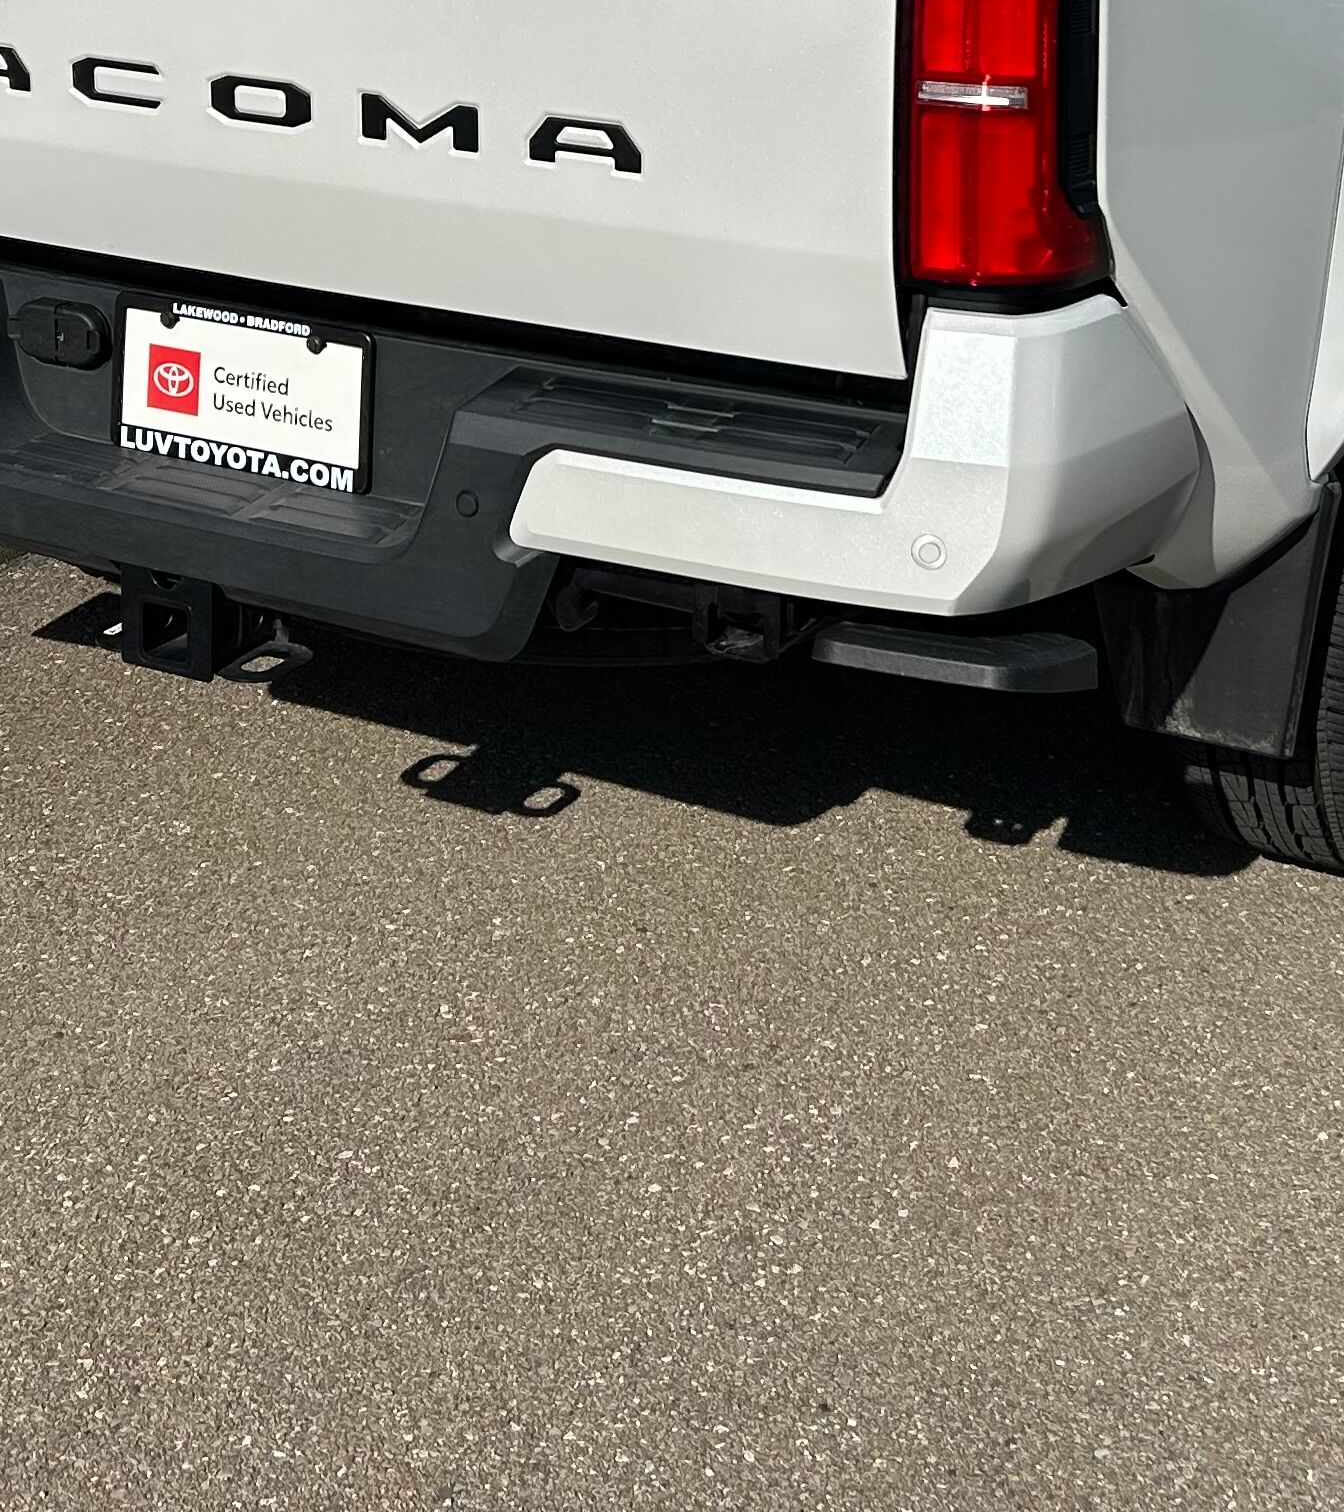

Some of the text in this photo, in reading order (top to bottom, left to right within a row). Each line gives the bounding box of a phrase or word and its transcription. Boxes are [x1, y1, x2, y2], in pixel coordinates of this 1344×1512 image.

[172, 302, 311, 337] LAKEWOOD BRADFORD
[213, 366, 290, 396] Certified
[212, 392, 334, 432] Used Vehicles
[120, 425, 354, 493] LUVTOYOTA.COM
